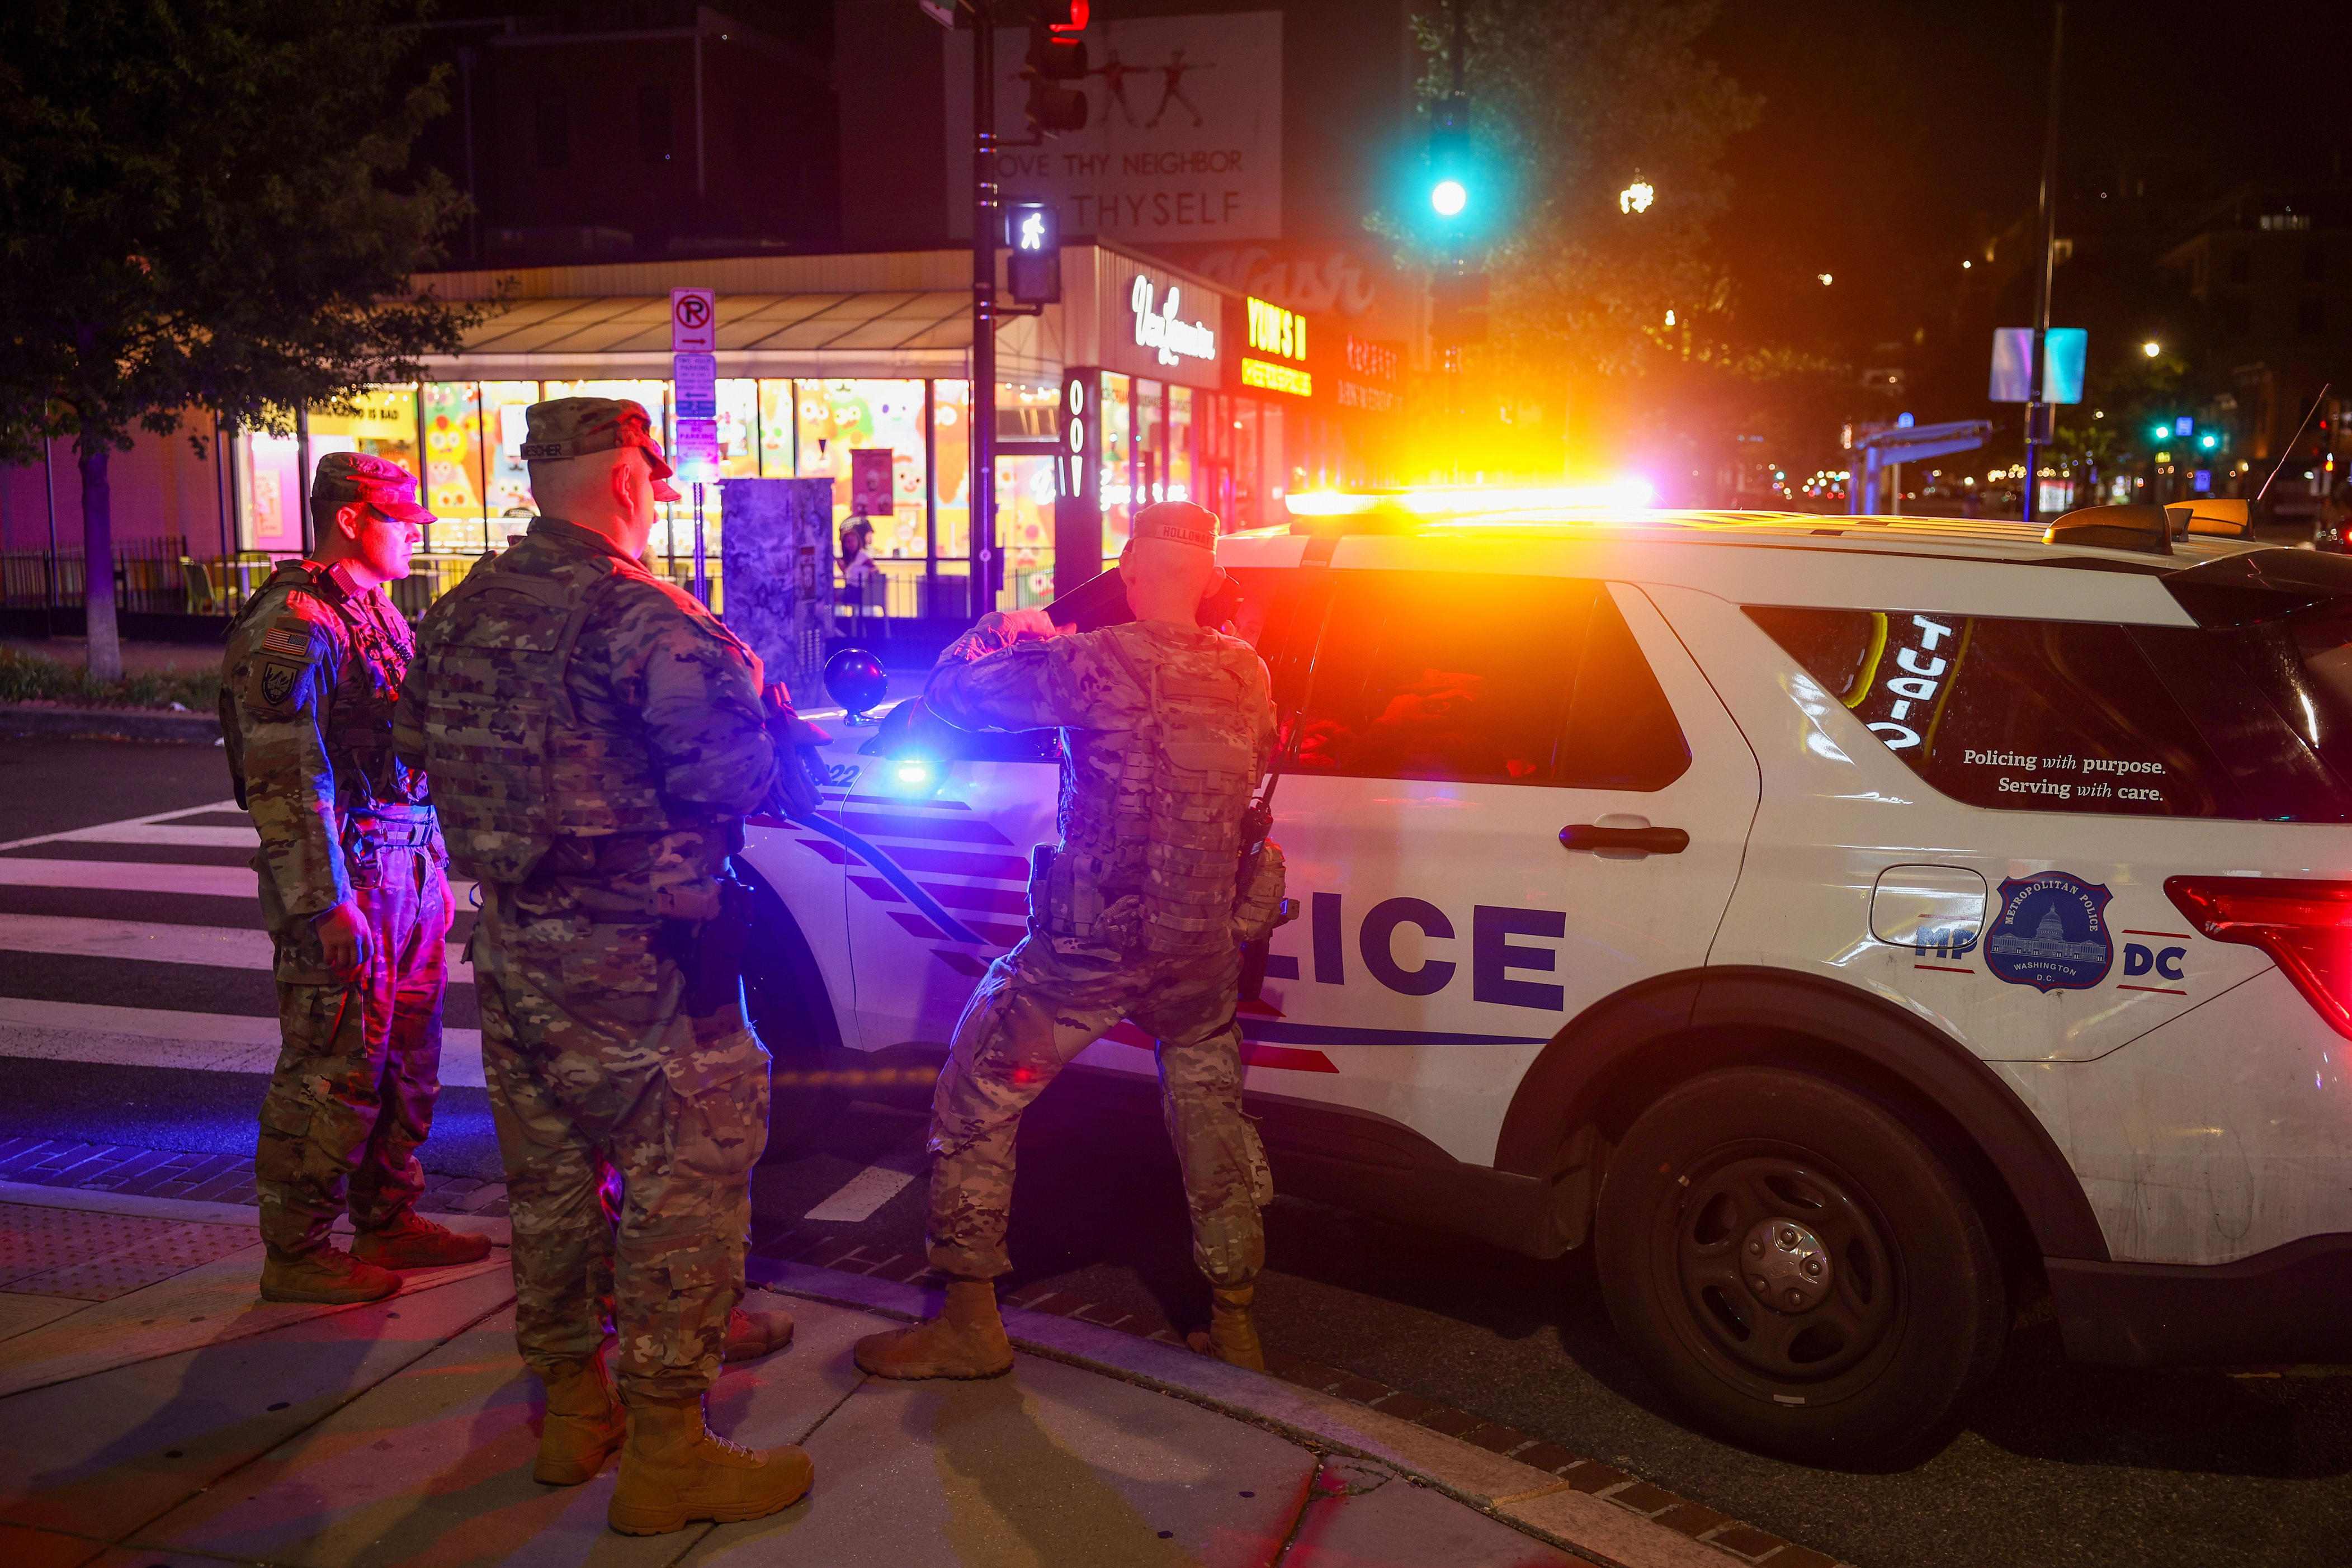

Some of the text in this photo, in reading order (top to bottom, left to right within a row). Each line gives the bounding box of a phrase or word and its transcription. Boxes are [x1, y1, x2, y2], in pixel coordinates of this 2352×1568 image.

[997, 150, 1243, 177] OVE THY NEIGHBOR
[1070, 191, 1240, 227] THYSELF
[380, 409, 399, 419] BAD
[1164, 527, 1211, 546] HOLLOWAY
[1963, 750, 2166, 776] Policing with purpose.
[1998, 777, 2164, 802] Serving with care.
[2005, 881, 2098, 932] METROPOLITAN POLICE
[1914, 926, 1977, 960] MP
[2014, 962, 2076, 976] WASHINGTON
[2123, 943, 2187, 981] DC
